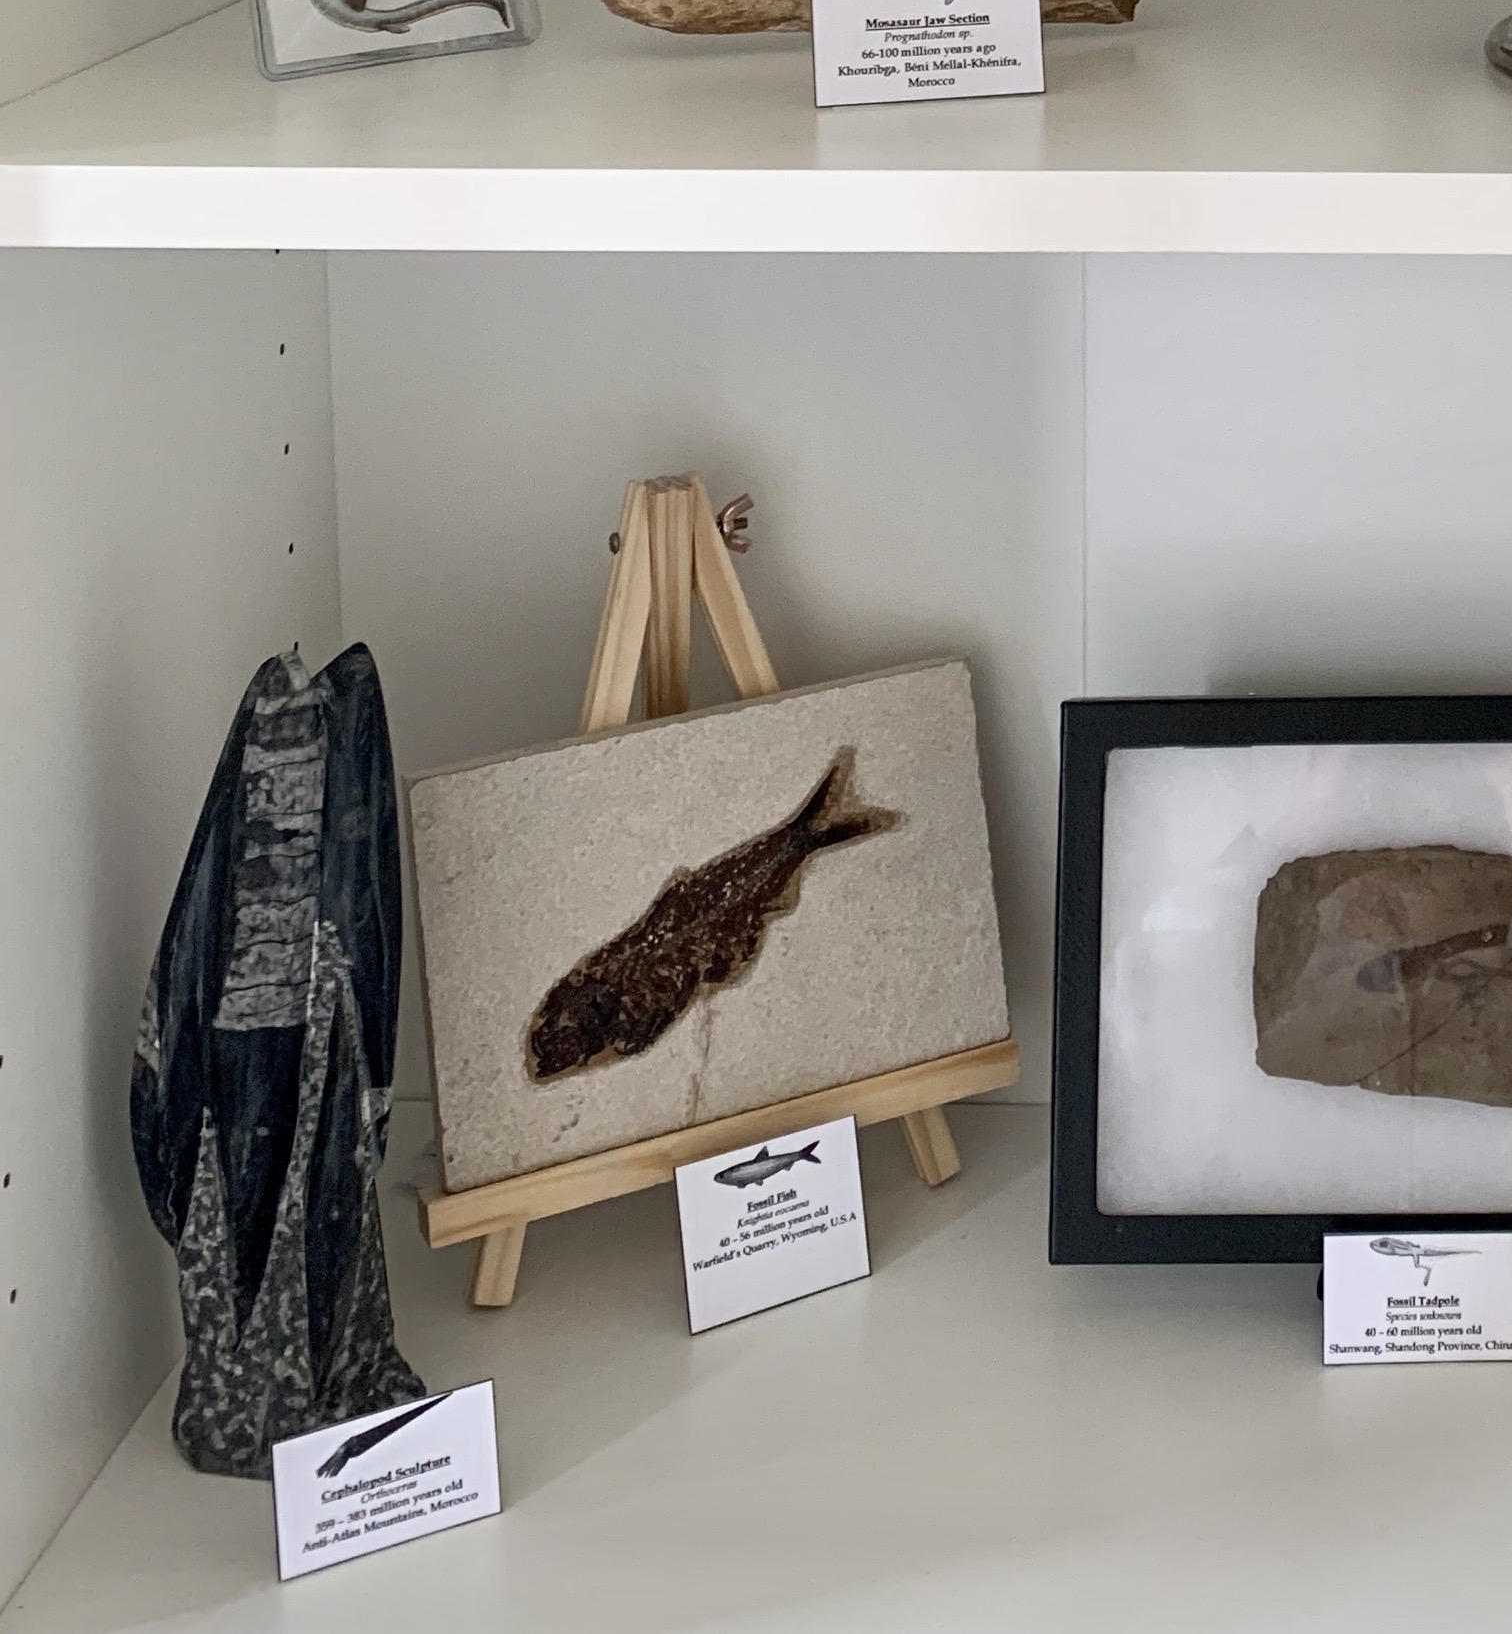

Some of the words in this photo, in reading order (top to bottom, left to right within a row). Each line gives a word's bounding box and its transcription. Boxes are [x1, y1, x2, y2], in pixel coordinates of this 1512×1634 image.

[866, 18, 921, 28] Mosasaur
[924, 16, 946, 27] Jaw
[950, 14, 989, 24] Section
[885, 30, 955, 44] Prognathodon
[959, 30, 973, 39] sp.
[862, 49, 898, 59] 66-100
[901, 46, 941, 57] million
[944, 46, 973, 56] years
[976, 44, 995, 55] ago
[838, 65, 900, 77] Khouribga,
[905, 62, 929, 72] Béni
[933, 57, 1021, 70] Mellal-Khénifra,
[908, 77, 955, 87] Morocco
[747, 1196, 774, 1213] Fossil
[777, 1189, 797, 1203] Fish
[720, 1238, 731, 1248] 40
[740, 1232, 751, 1243] 56
[753, 1221, 786, 1238] million
[788, 1212, 812, 1229] years
[814, 1206, 829, 1219] old
[737, 1211, 773, 1229] Knightia
[743, 1238, 779, 1256] Quarry,
[782, 1223, 828, 1244] Wyoming,
[1387, 1297, 1416, 1306] Fossil
[1419, 1296, 1460, 1307] Tadpole
[1386, 1312, 1417, 1323] Species
[1420, 1312, 1461, 1320] unknown
[1365, 1328, 1376, 1336] 40
[1387, 1328, 1398, 1336] 60
[1401, 1326, 1435, 1336] million
[1438, 1327, 1463, 1337] years
[1466, 1325, 1482, 1335] old
[1329, 1344, 1383, 1355] Shanwang,
[1385, 1342, 1434, 1353] Shandong
[1438, 1341, 1483, 1351] Province,
[321, 1471, 392, 1501] Cephalopod
[395, 1456, 451, 1479] Sculpture
[370, 1498, 410, 1517] million
[413, 1487, 442, 1506] years
[445, 1479, 463, 1493] old
[302, 1528, 361, 1553] Anti-Atlas
[364, 1509, 427, 1533] Mountains,
[430, 1491, 479, 1513] Morocco
